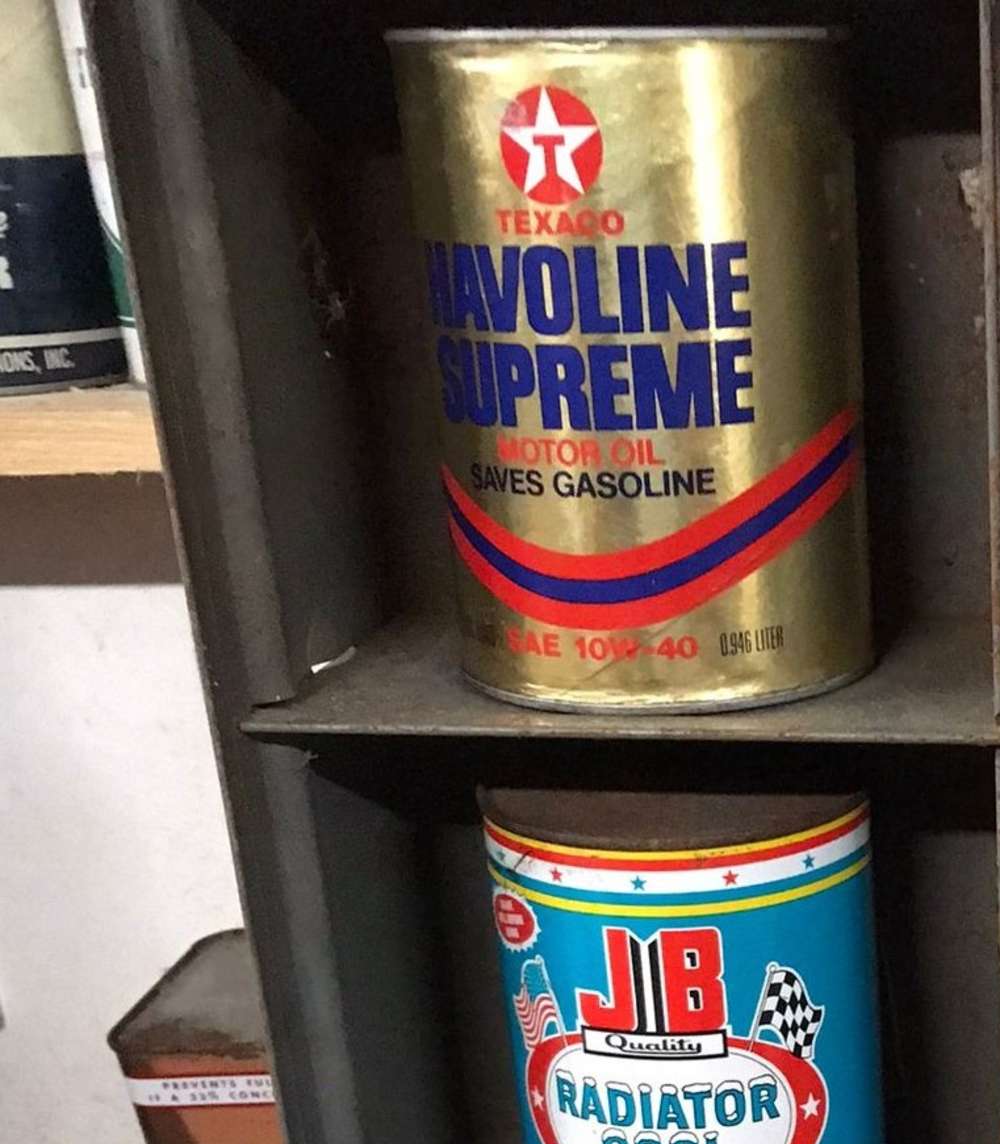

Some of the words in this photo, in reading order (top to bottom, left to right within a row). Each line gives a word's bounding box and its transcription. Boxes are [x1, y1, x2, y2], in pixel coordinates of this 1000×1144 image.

[496, 209, 625, 237] TEXACO
[427, 241, 752, 336] HAVOLINE
[437, 334, 755, 430] SUPREME
[497, 437, 599, 466] MOTOR
[611, 439, 665, 466] OIL
[470, 463, 545, 496] SAVES
[553, 467, 717, 499] GASOLINE
[505, 629, 561, 658] SAE
[575, 635, 699, 662] 10W-40
[719, 629, 753, 657] 0.946
[754, 625, 784, 653] LITER
[605, 1034, 703, 1056] Quality
[554, 1068, 781, 1130] RADIATOR
